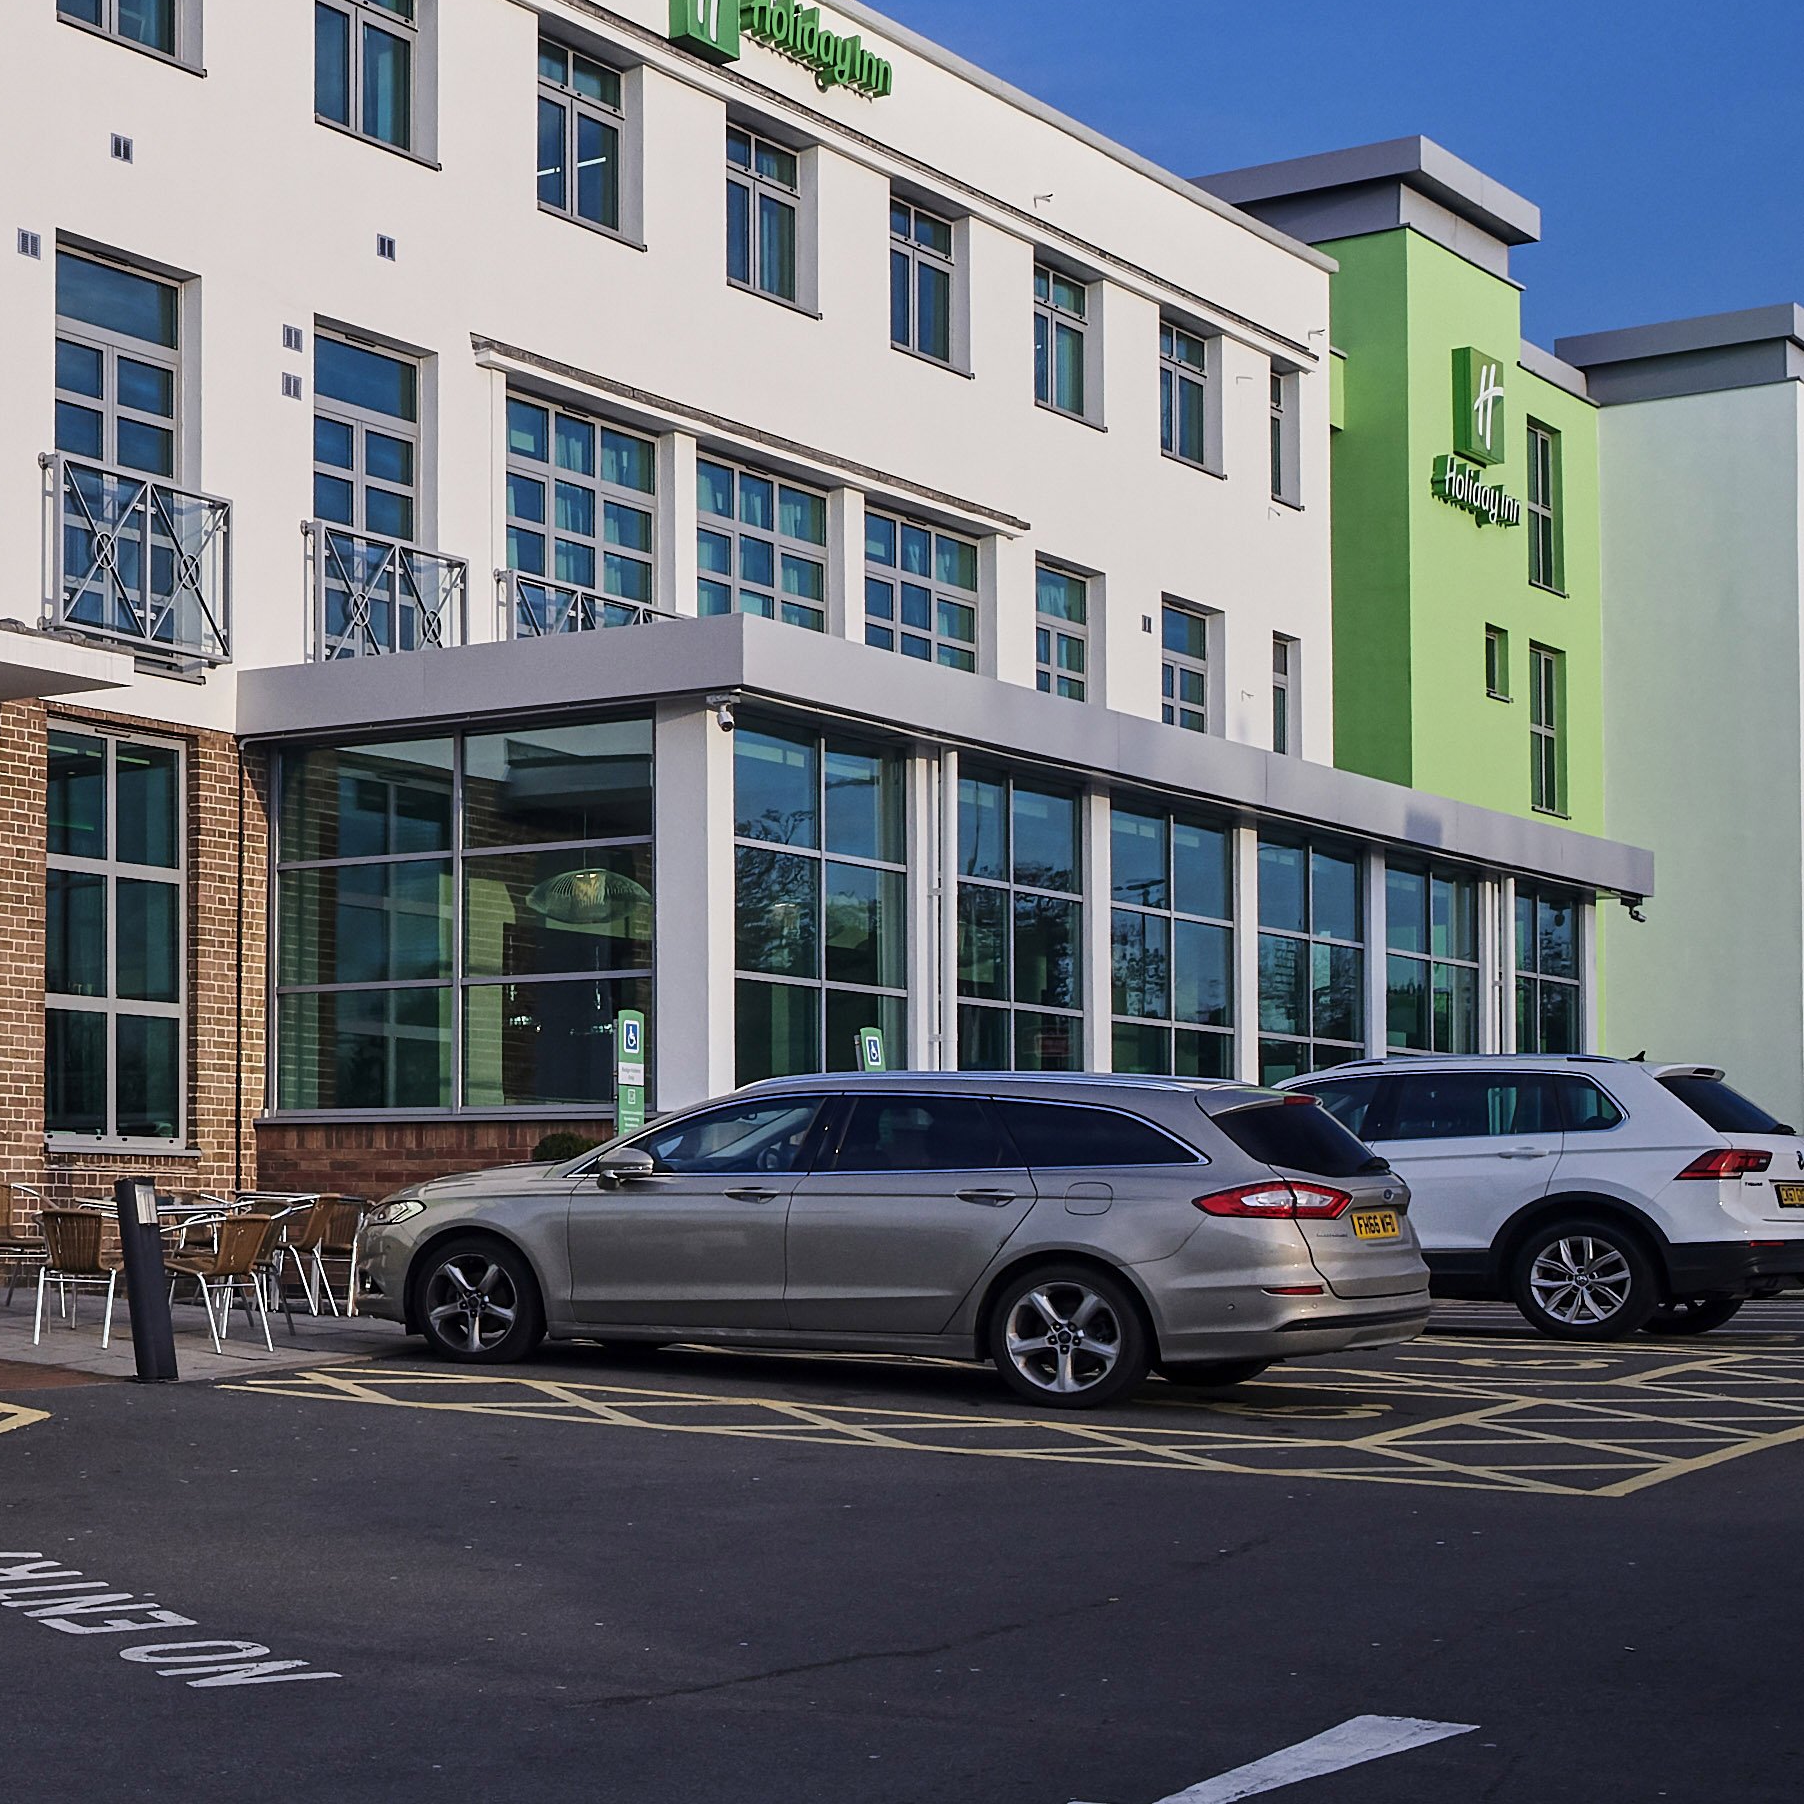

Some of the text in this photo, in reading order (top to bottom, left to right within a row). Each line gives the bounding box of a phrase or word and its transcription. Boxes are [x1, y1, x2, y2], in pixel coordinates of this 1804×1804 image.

[854, 35, 892, 97] Inn
[1442, 455, 1521, 525] Holiday Inn
[119, 1640, 343, 1688] NO
